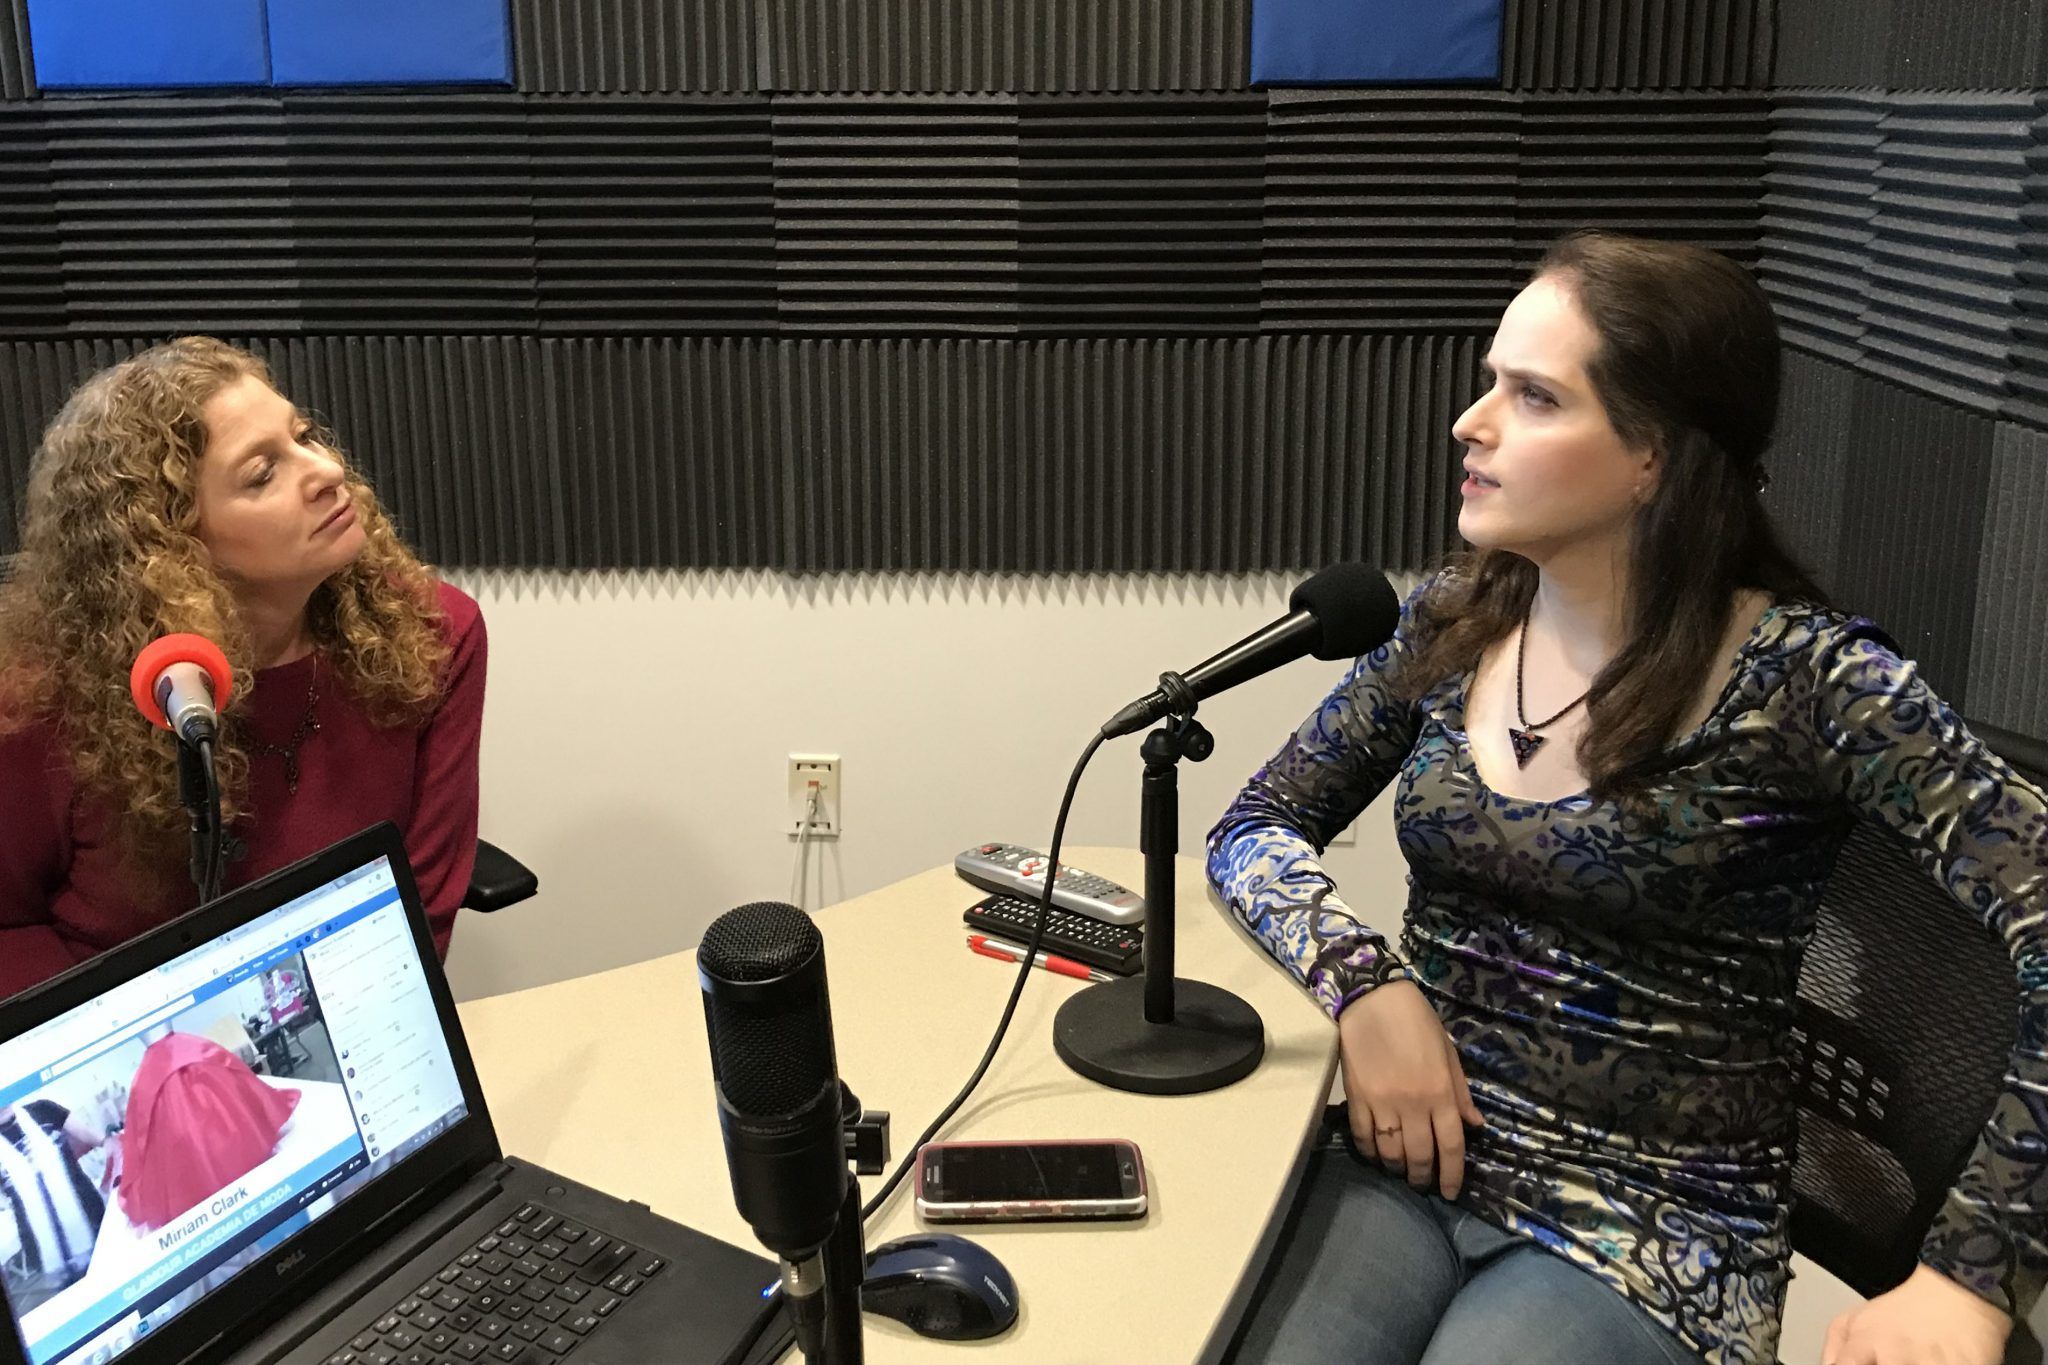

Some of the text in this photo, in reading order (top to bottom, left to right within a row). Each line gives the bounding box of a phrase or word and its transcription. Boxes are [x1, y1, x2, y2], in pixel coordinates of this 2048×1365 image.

[122, 1183, 293, 1300] GLAMOUR ACADEMIA DE MODA
[158, 1185, 249, 1251] Miriam Clark
[276, 1248, 307, 1276] DELL
